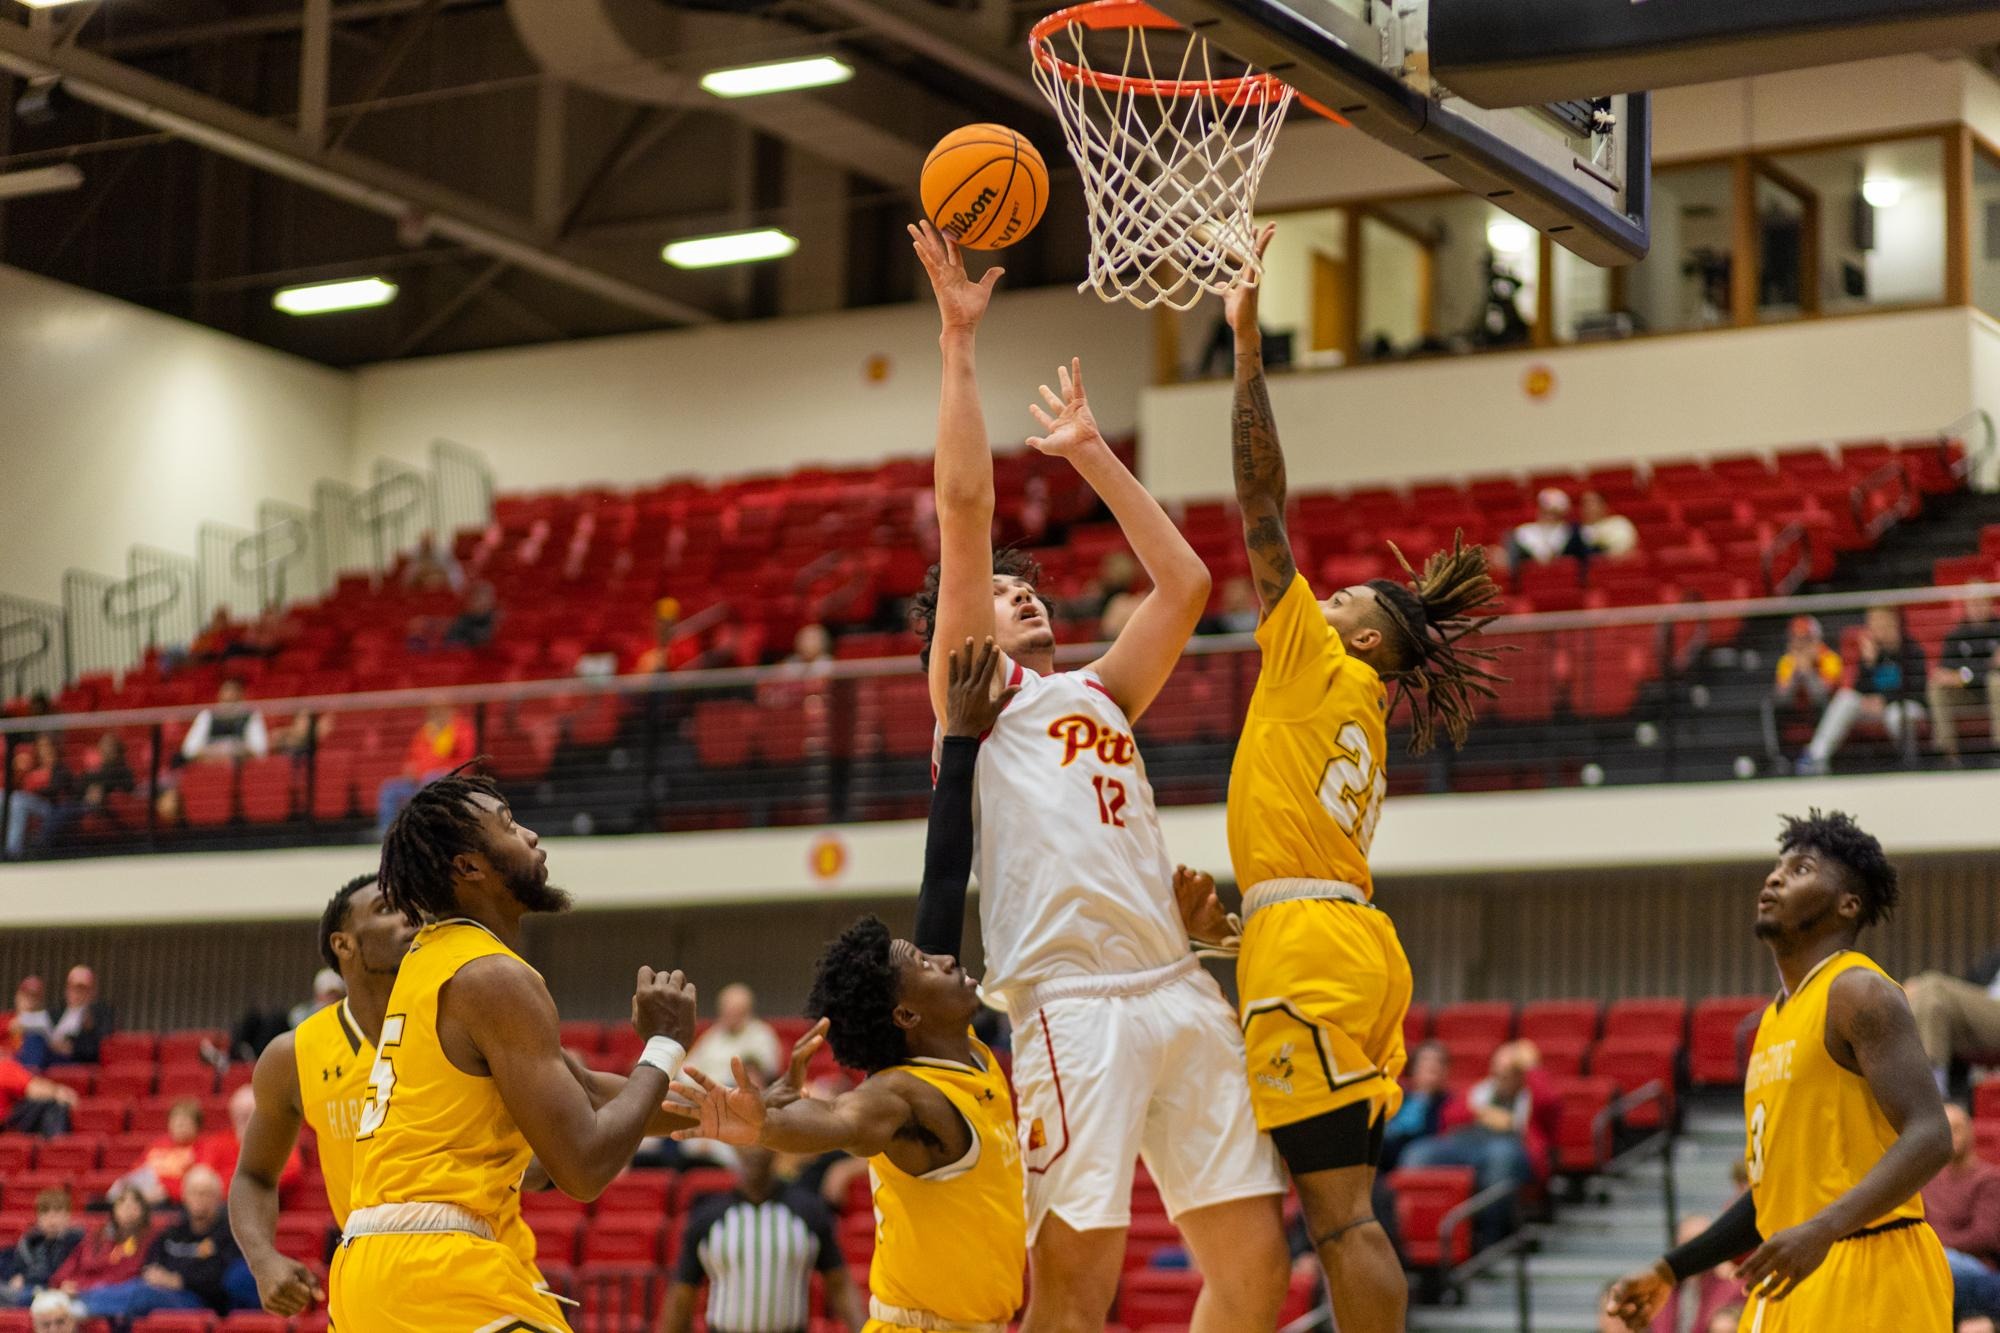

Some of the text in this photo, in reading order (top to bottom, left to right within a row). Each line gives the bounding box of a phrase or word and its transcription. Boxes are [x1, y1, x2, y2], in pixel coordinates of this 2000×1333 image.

[1092, 775, 1126, 828] 12
[326, 1097, 366, 1139] HAR
[1746, 1100, 1767, 1187] 3
